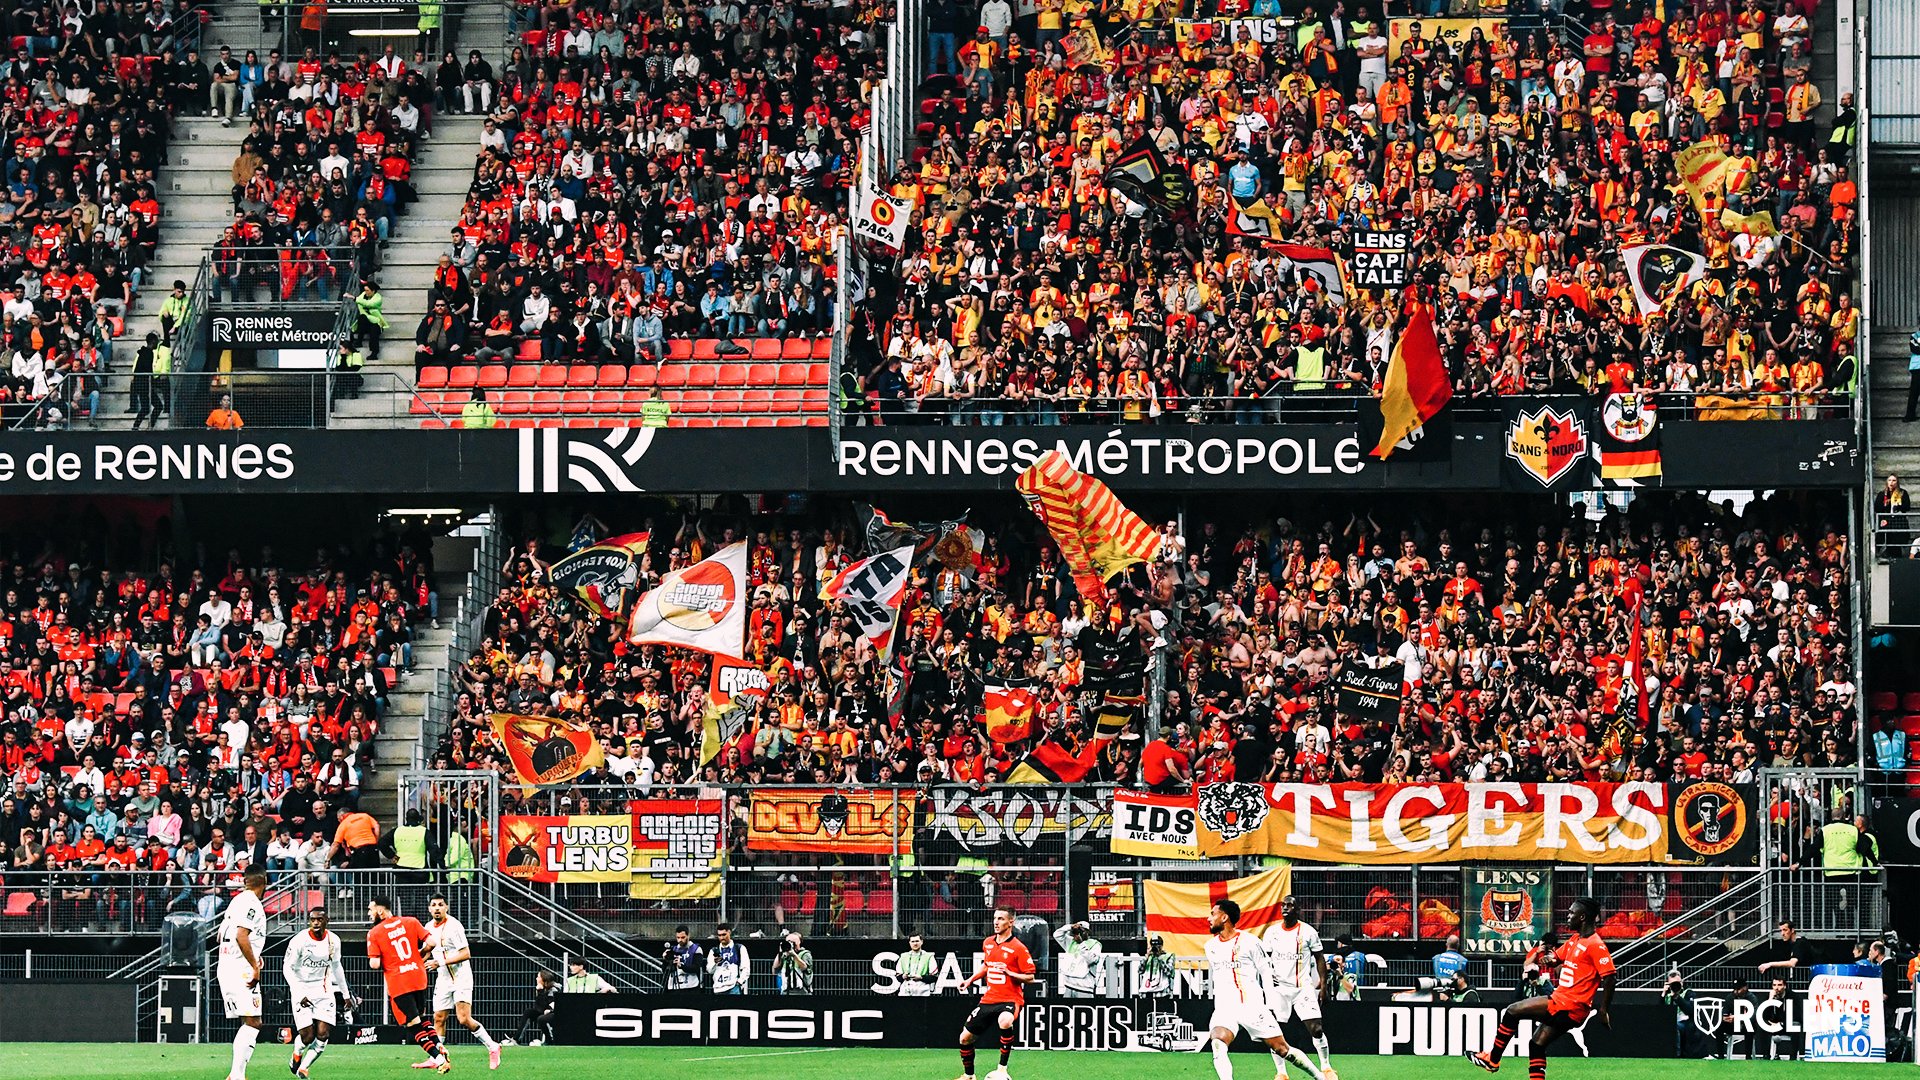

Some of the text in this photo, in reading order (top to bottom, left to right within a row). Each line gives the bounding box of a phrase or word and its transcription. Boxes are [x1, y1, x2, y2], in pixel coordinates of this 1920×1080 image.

[869, 182, 905, 207] LENS
[857, 218, 895, 243] PACA
[1354, 232, 1406, 248] LENS
[1355, 252, 1405, 268] CAPI
[1355, 269, 1403, 284] TALE
[235, 330, 346, 344] Ville et Métropoe
[1512, 441, 1541, 457] SANG
[26, 446, 81, 481] de
[1345, 670, 1398, 693] Red Tigers
[1357, 695, 1379, 709] 1994
[1676, 783, 1741, 808] ULTRAS TIGERS
[639, 814, 720, 841] ARTOIS
[1124, 803, 1195, 835] IDS
[1270, 781, 1664, 853] TIGERS
[546, 826, 629, 845] TURBU
[667, 833, 716, 860] LENS
[1129, 832, 1188, 844] AVEC NOUS
[1684, 832, 1740, 854] CAPITALE
[546, 846, 629, 872] LENS
[1475, 870, 1540, 886] LENS
[1488, 920, 1508, 929] LENS
[391, 936, 412, 961] 10
[1465, 938, 1544, 953] MCMV
[595, 1007, 884, 1040] SAMSIC
[1049, 1004, 1133, 1051] BRIS
[1813, 1034, 1870, 1057] MALO
